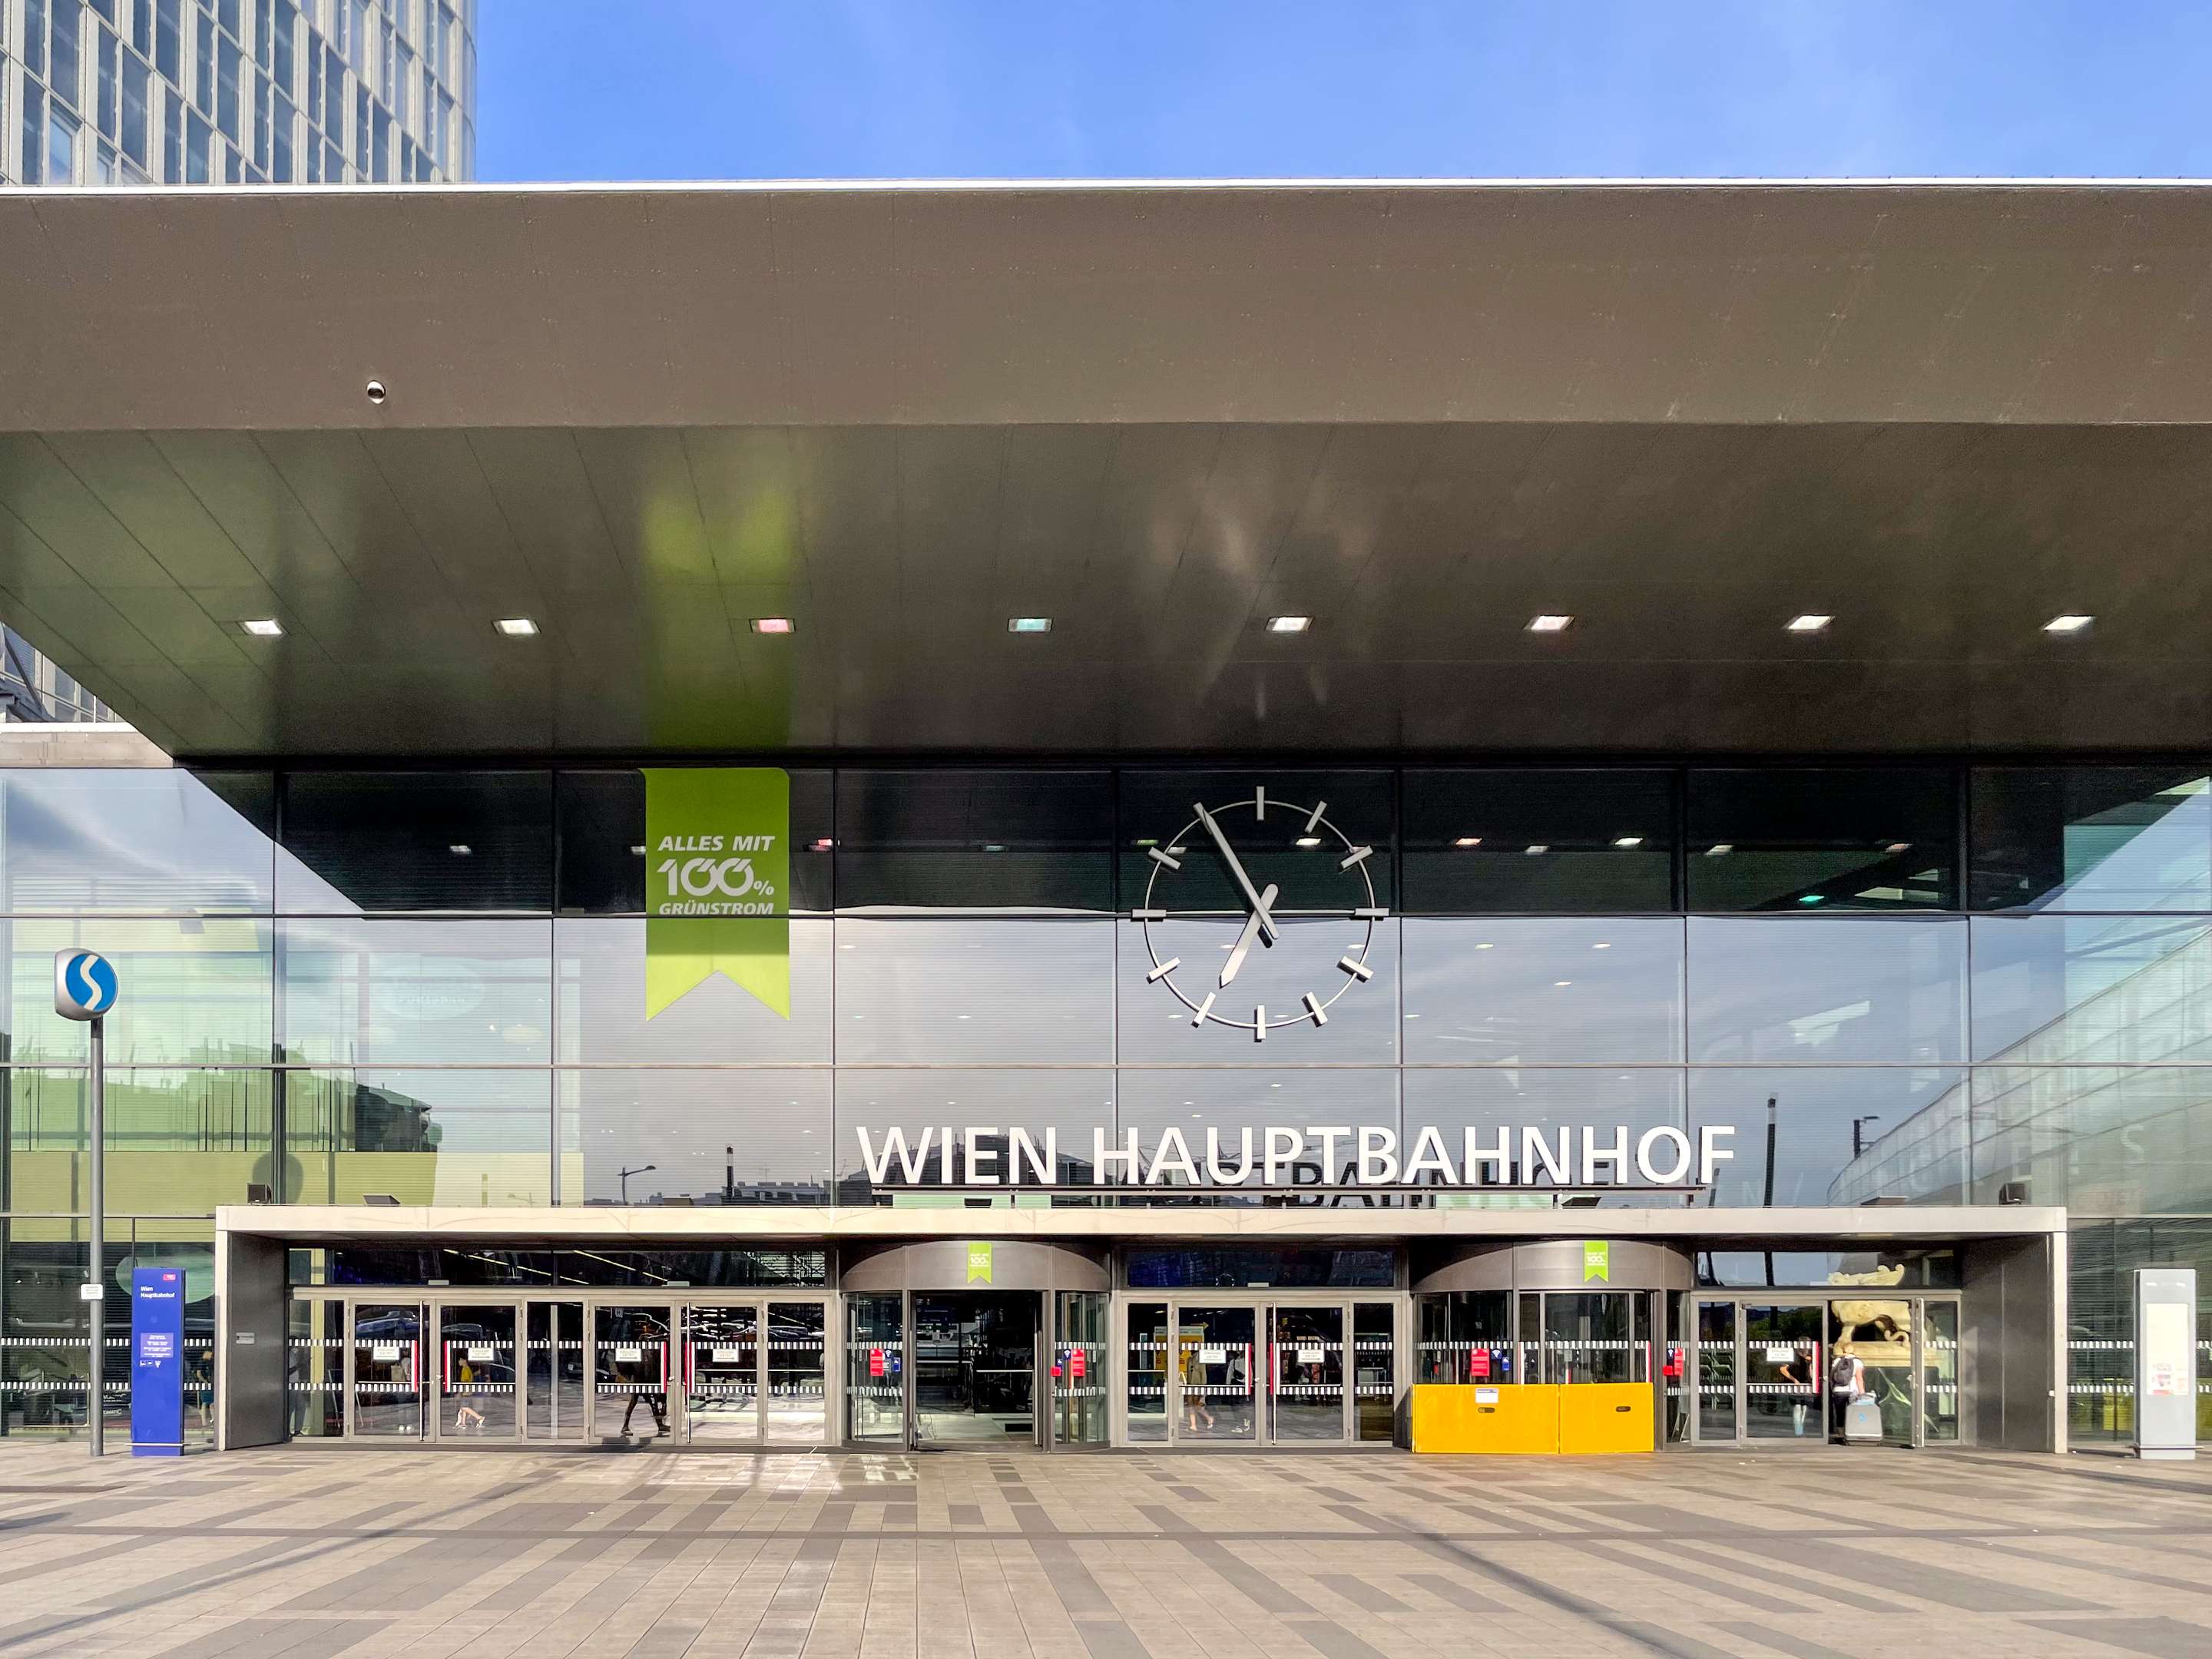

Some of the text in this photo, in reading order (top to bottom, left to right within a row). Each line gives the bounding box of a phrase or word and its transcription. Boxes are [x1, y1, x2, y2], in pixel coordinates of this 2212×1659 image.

[657, 836, 775, 852] ALLES MIT
[657, 857, 775, 897] 100%
[658, 899, 774, 915] GRÜNSTROM
[856, 1126, 1056, 1184] WIEN
[1093, 1125, 1736, 1184] HAUPTBAHNHOF
